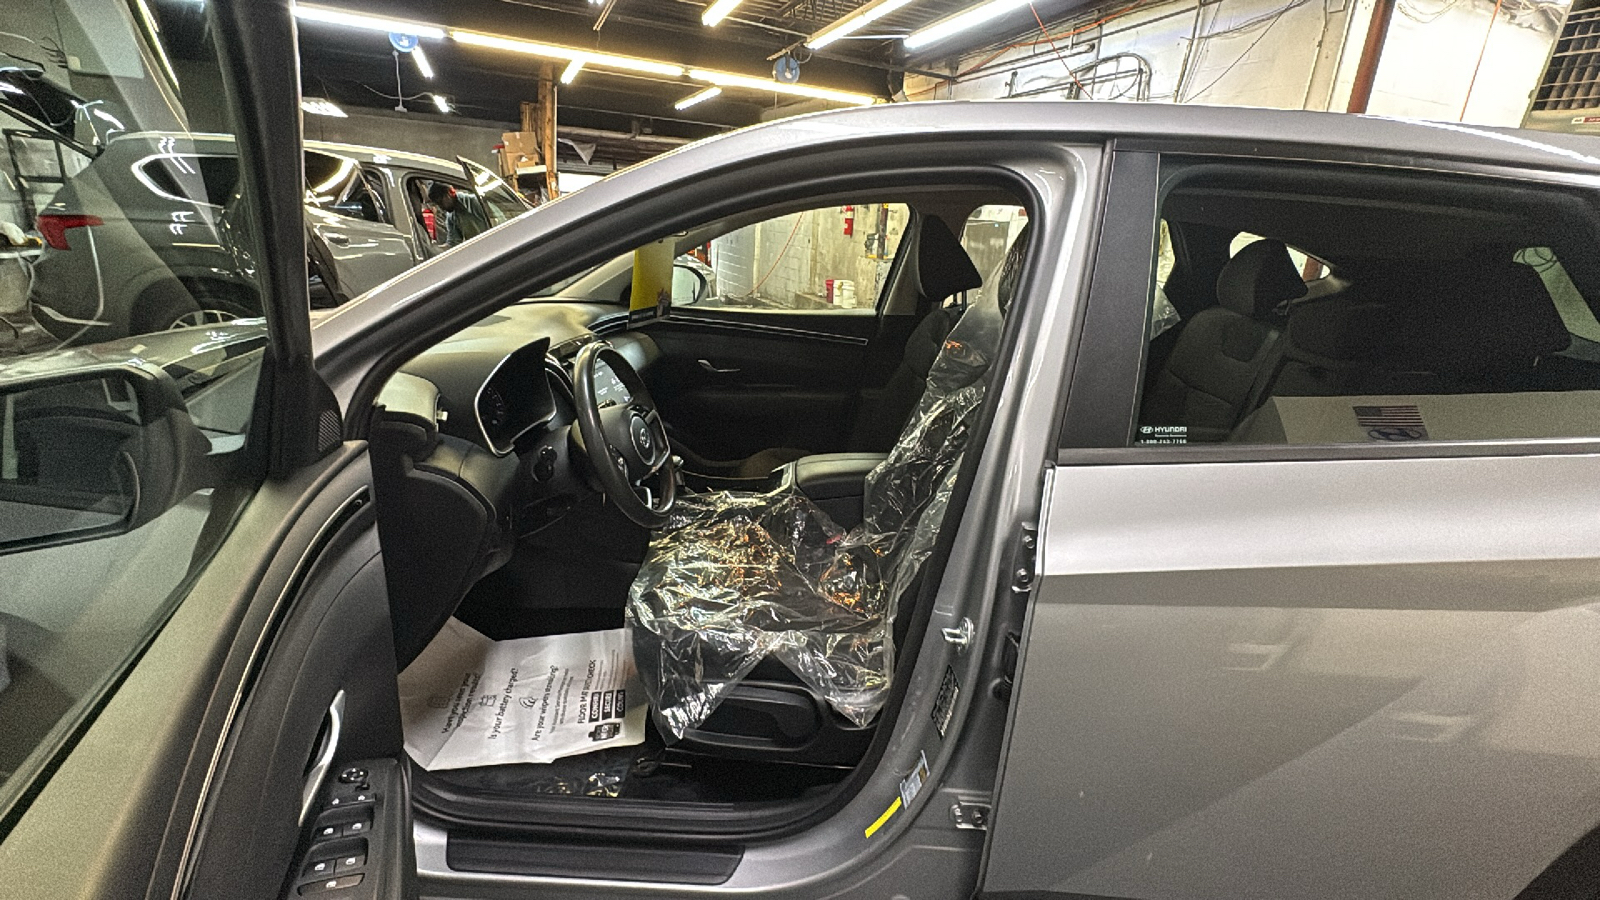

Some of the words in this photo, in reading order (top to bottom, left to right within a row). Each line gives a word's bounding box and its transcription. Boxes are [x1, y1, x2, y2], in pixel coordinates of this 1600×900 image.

[504, 667, 519, 693] charged?
[496, 694, 513, 716] battery
[577, 702, 587, 723] FLOOR
[492, 716, 502, 733] your
[530, 729, 542, 741] Are
[536, 715, 546, 728] your
[541, 692, 551, 713] wipers
